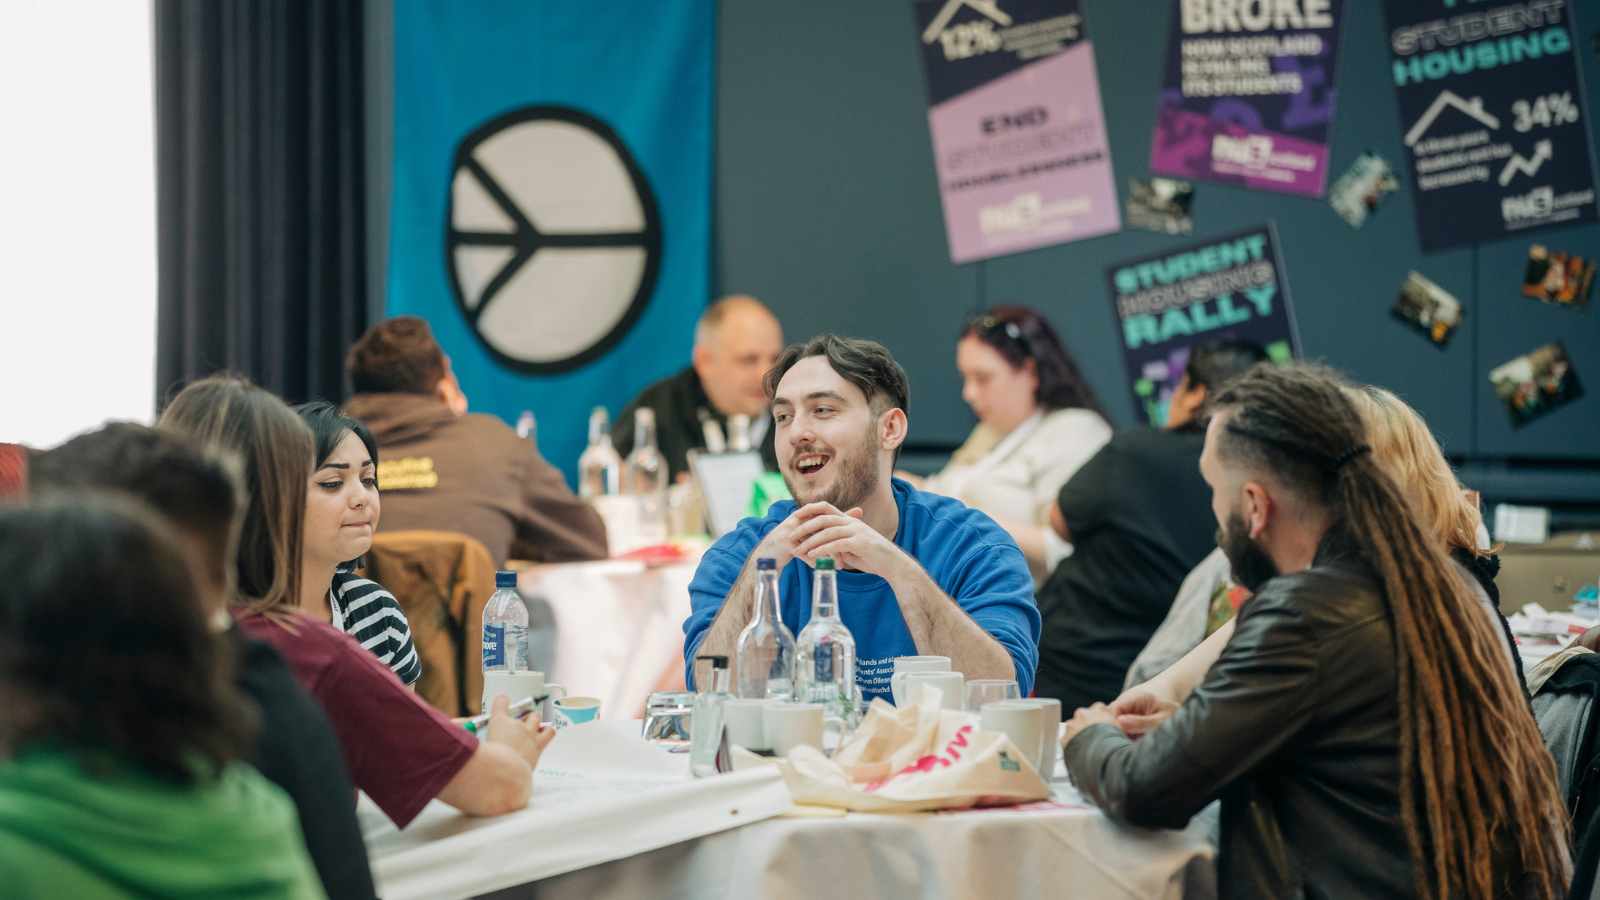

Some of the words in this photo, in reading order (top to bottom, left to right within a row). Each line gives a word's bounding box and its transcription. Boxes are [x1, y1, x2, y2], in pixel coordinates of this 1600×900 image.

[1181, 0, 1334, 33] BROKE
[1391, 0, 1566, 55] STUDENT
[1392, 26, 1571, 86] HOUSING
[980, 106, 1048, 135] END
[1511, 91, 1579, 133] 34%
[1115, 233, 1266, 295] STUDENT
[1117, 260, 1274, 319] HOUSING
[1123, 283, 1276, 349] RALLY
